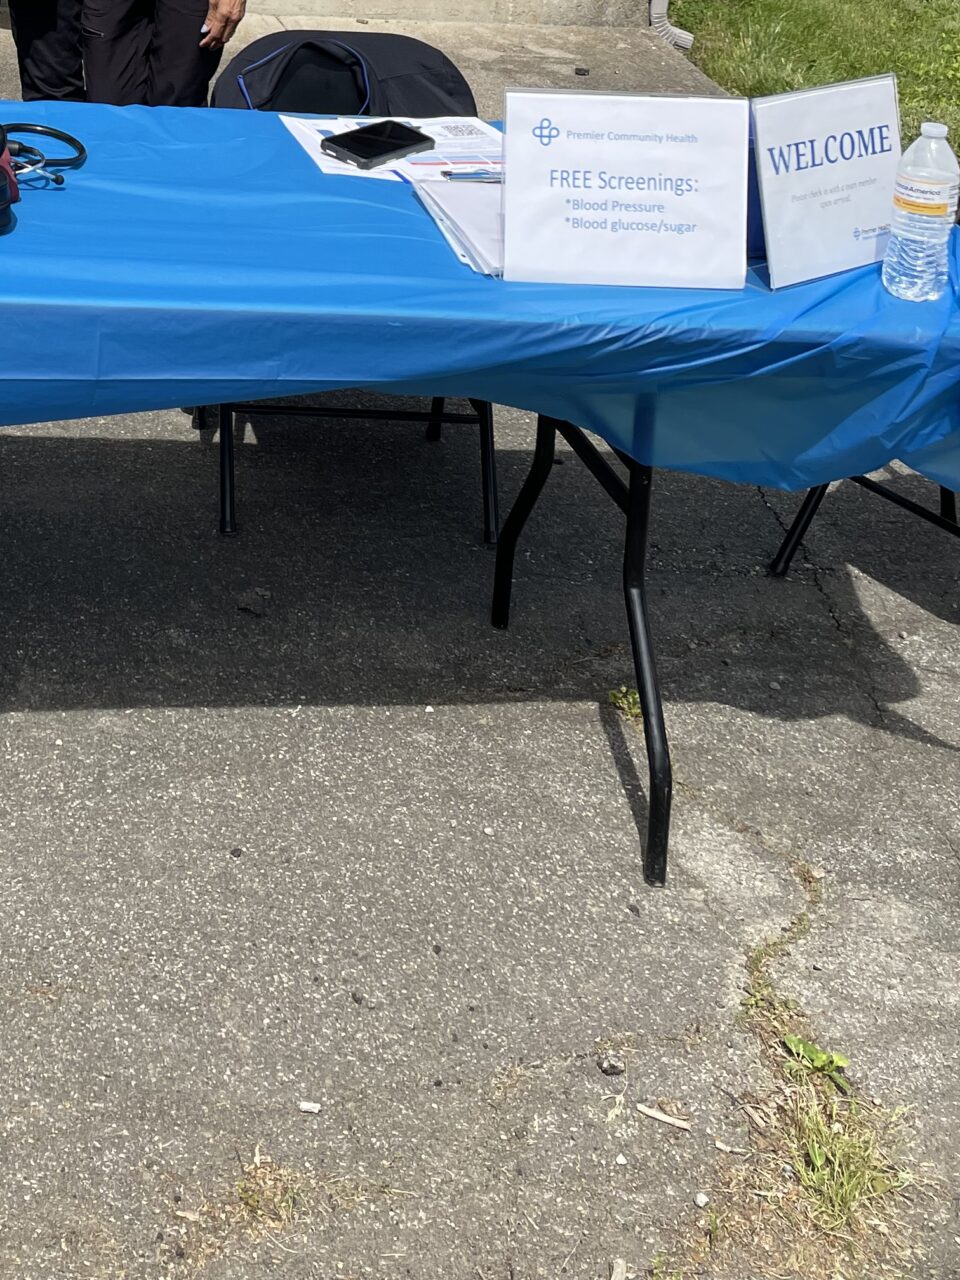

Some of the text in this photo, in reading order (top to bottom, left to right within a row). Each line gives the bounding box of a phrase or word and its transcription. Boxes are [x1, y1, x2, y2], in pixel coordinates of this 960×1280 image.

[566, 130, 699, 144] Premier Community Health
[767, 124, 892, 176] WELCOME
[549, 169, 699, 196] FREE Screenings:
[611, 200, 665, 213] Pressure
[611, 219, 697, 235] glucose/sugar
